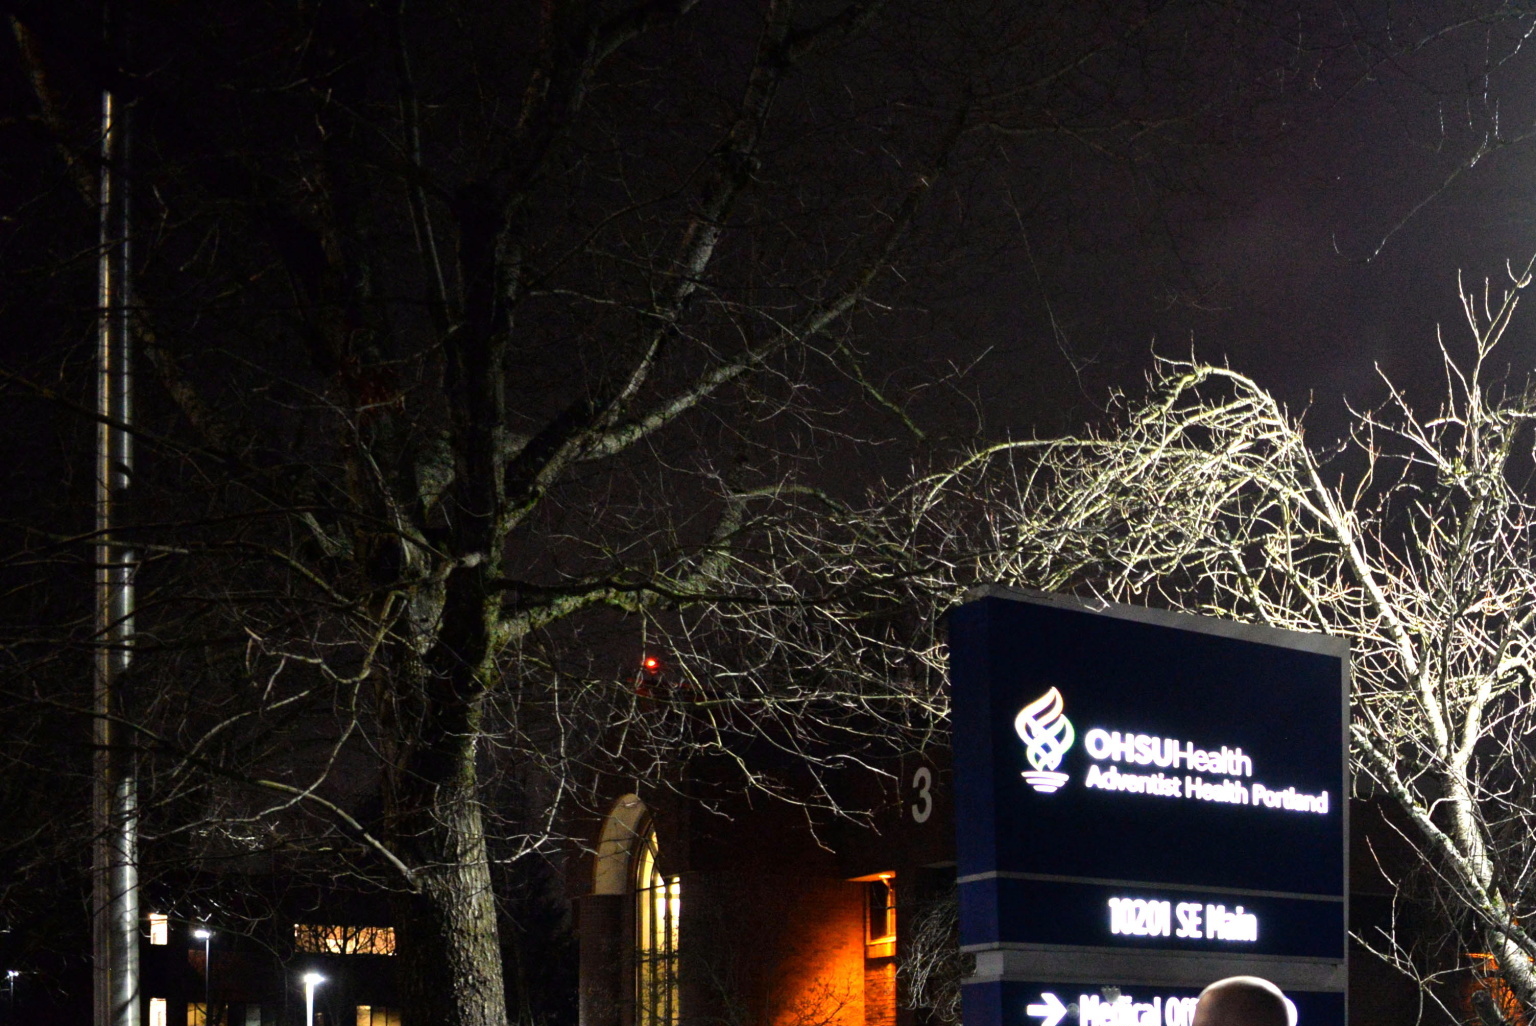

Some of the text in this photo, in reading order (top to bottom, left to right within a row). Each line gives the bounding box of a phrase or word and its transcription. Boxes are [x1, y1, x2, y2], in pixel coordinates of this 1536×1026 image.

[911, 766, 933, 823] 3
[1085, 764, 1328, 814] Adventist Health Portland
[1108, 897, 1257, 941] 10201 SE Main
